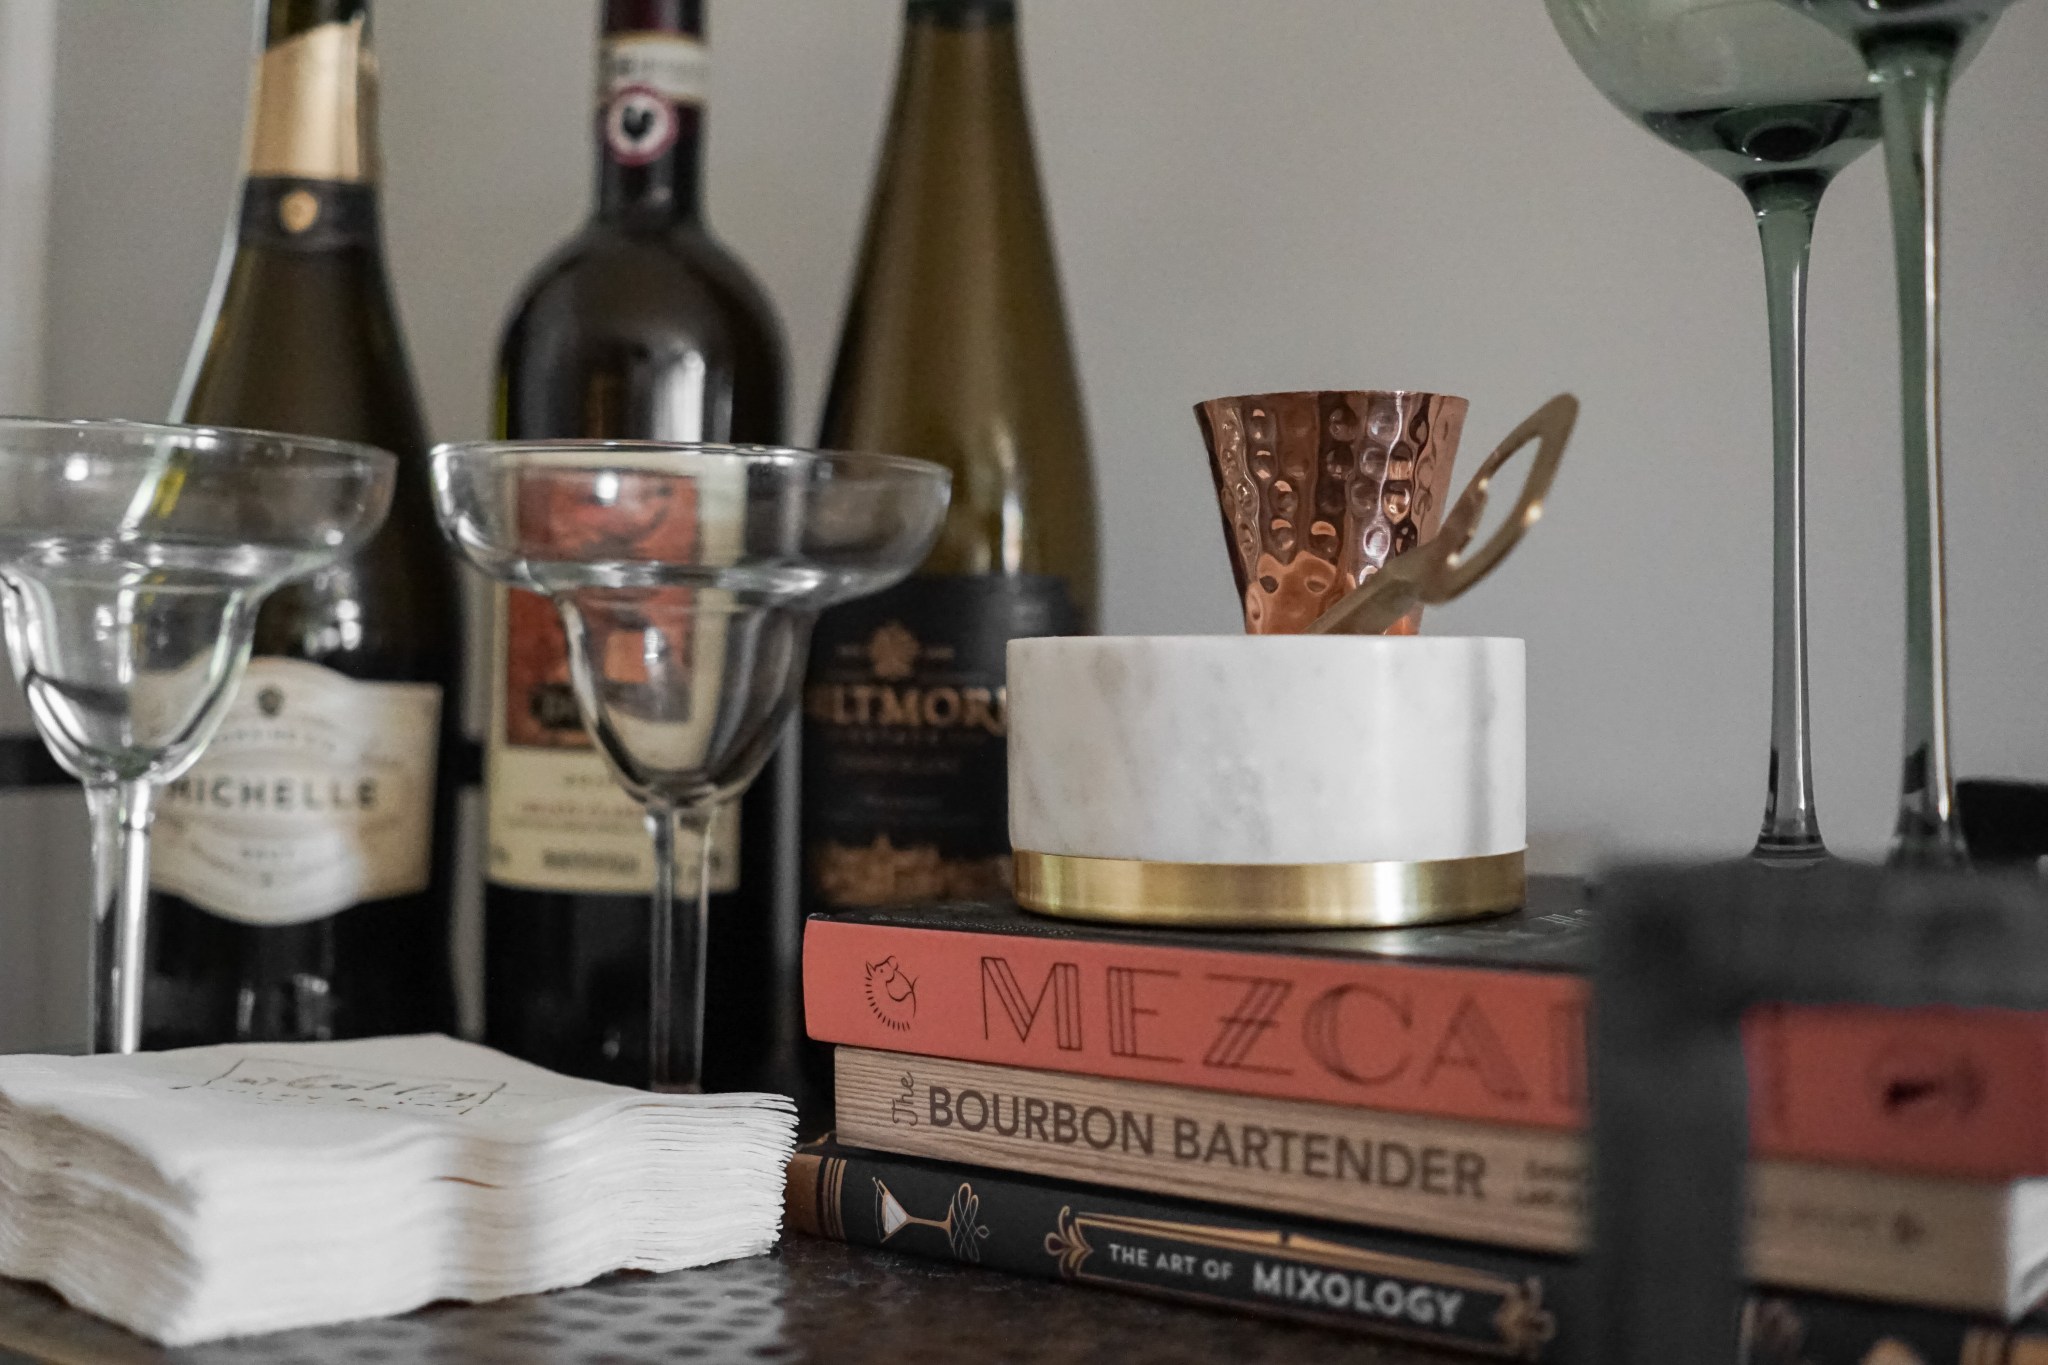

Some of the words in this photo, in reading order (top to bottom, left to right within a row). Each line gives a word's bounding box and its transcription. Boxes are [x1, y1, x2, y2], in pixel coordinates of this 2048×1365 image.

[891, 1071, 919, 1127] The
[929, 1085, 1155, 1155] BOURBON
[1173, 1116, 1488, 1199] BARTENDER
[1109, 1243, 1149, 1268] THE
[1156, 1253, 1199, 1277] ART
[1202, 1259, 1234, 1282] OF
[1252, 1261, 1464, 1328] MIXOLOGY
